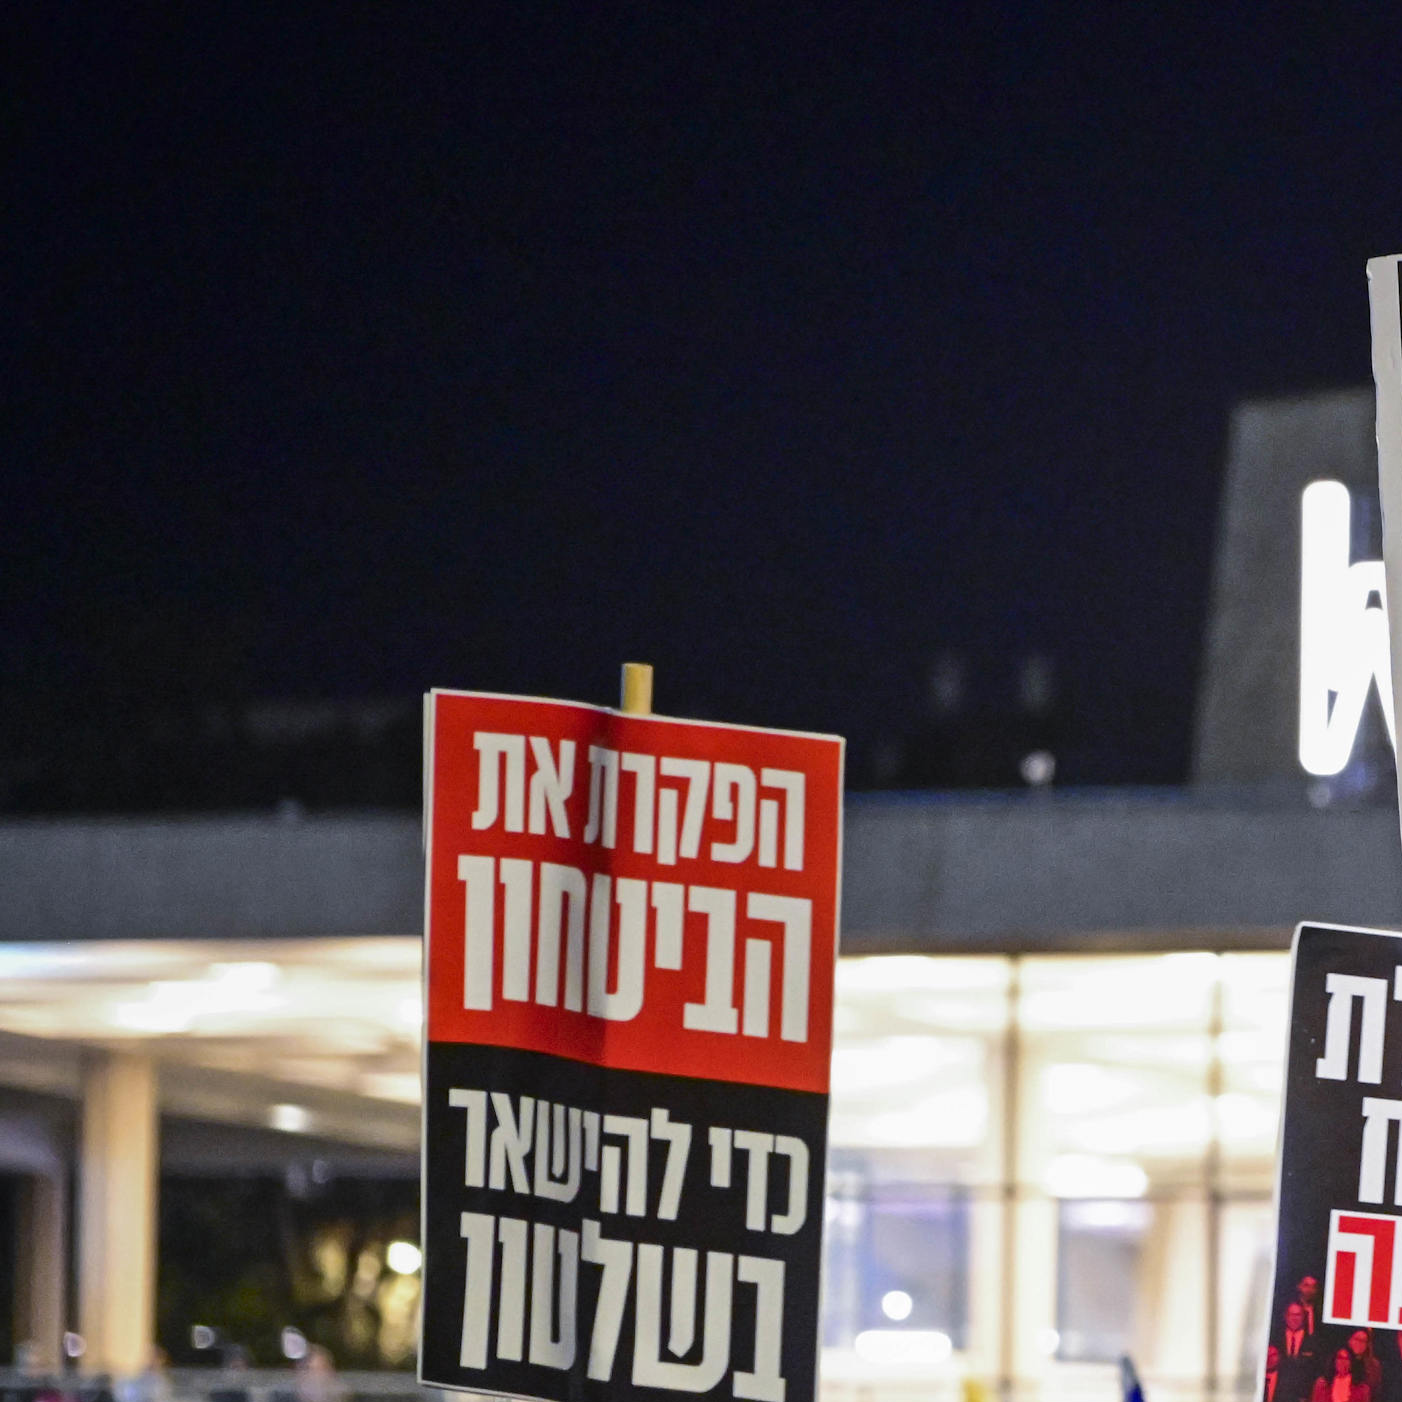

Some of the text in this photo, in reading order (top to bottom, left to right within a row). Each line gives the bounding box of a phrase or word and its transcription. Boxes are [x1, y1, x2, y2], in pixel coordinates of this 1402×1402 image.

[472, 731, 805, 872] הפקרת את
[457, 855, 811, 1043] הביטחון
[448, 1088, 809, 1236] כדי להישאר
